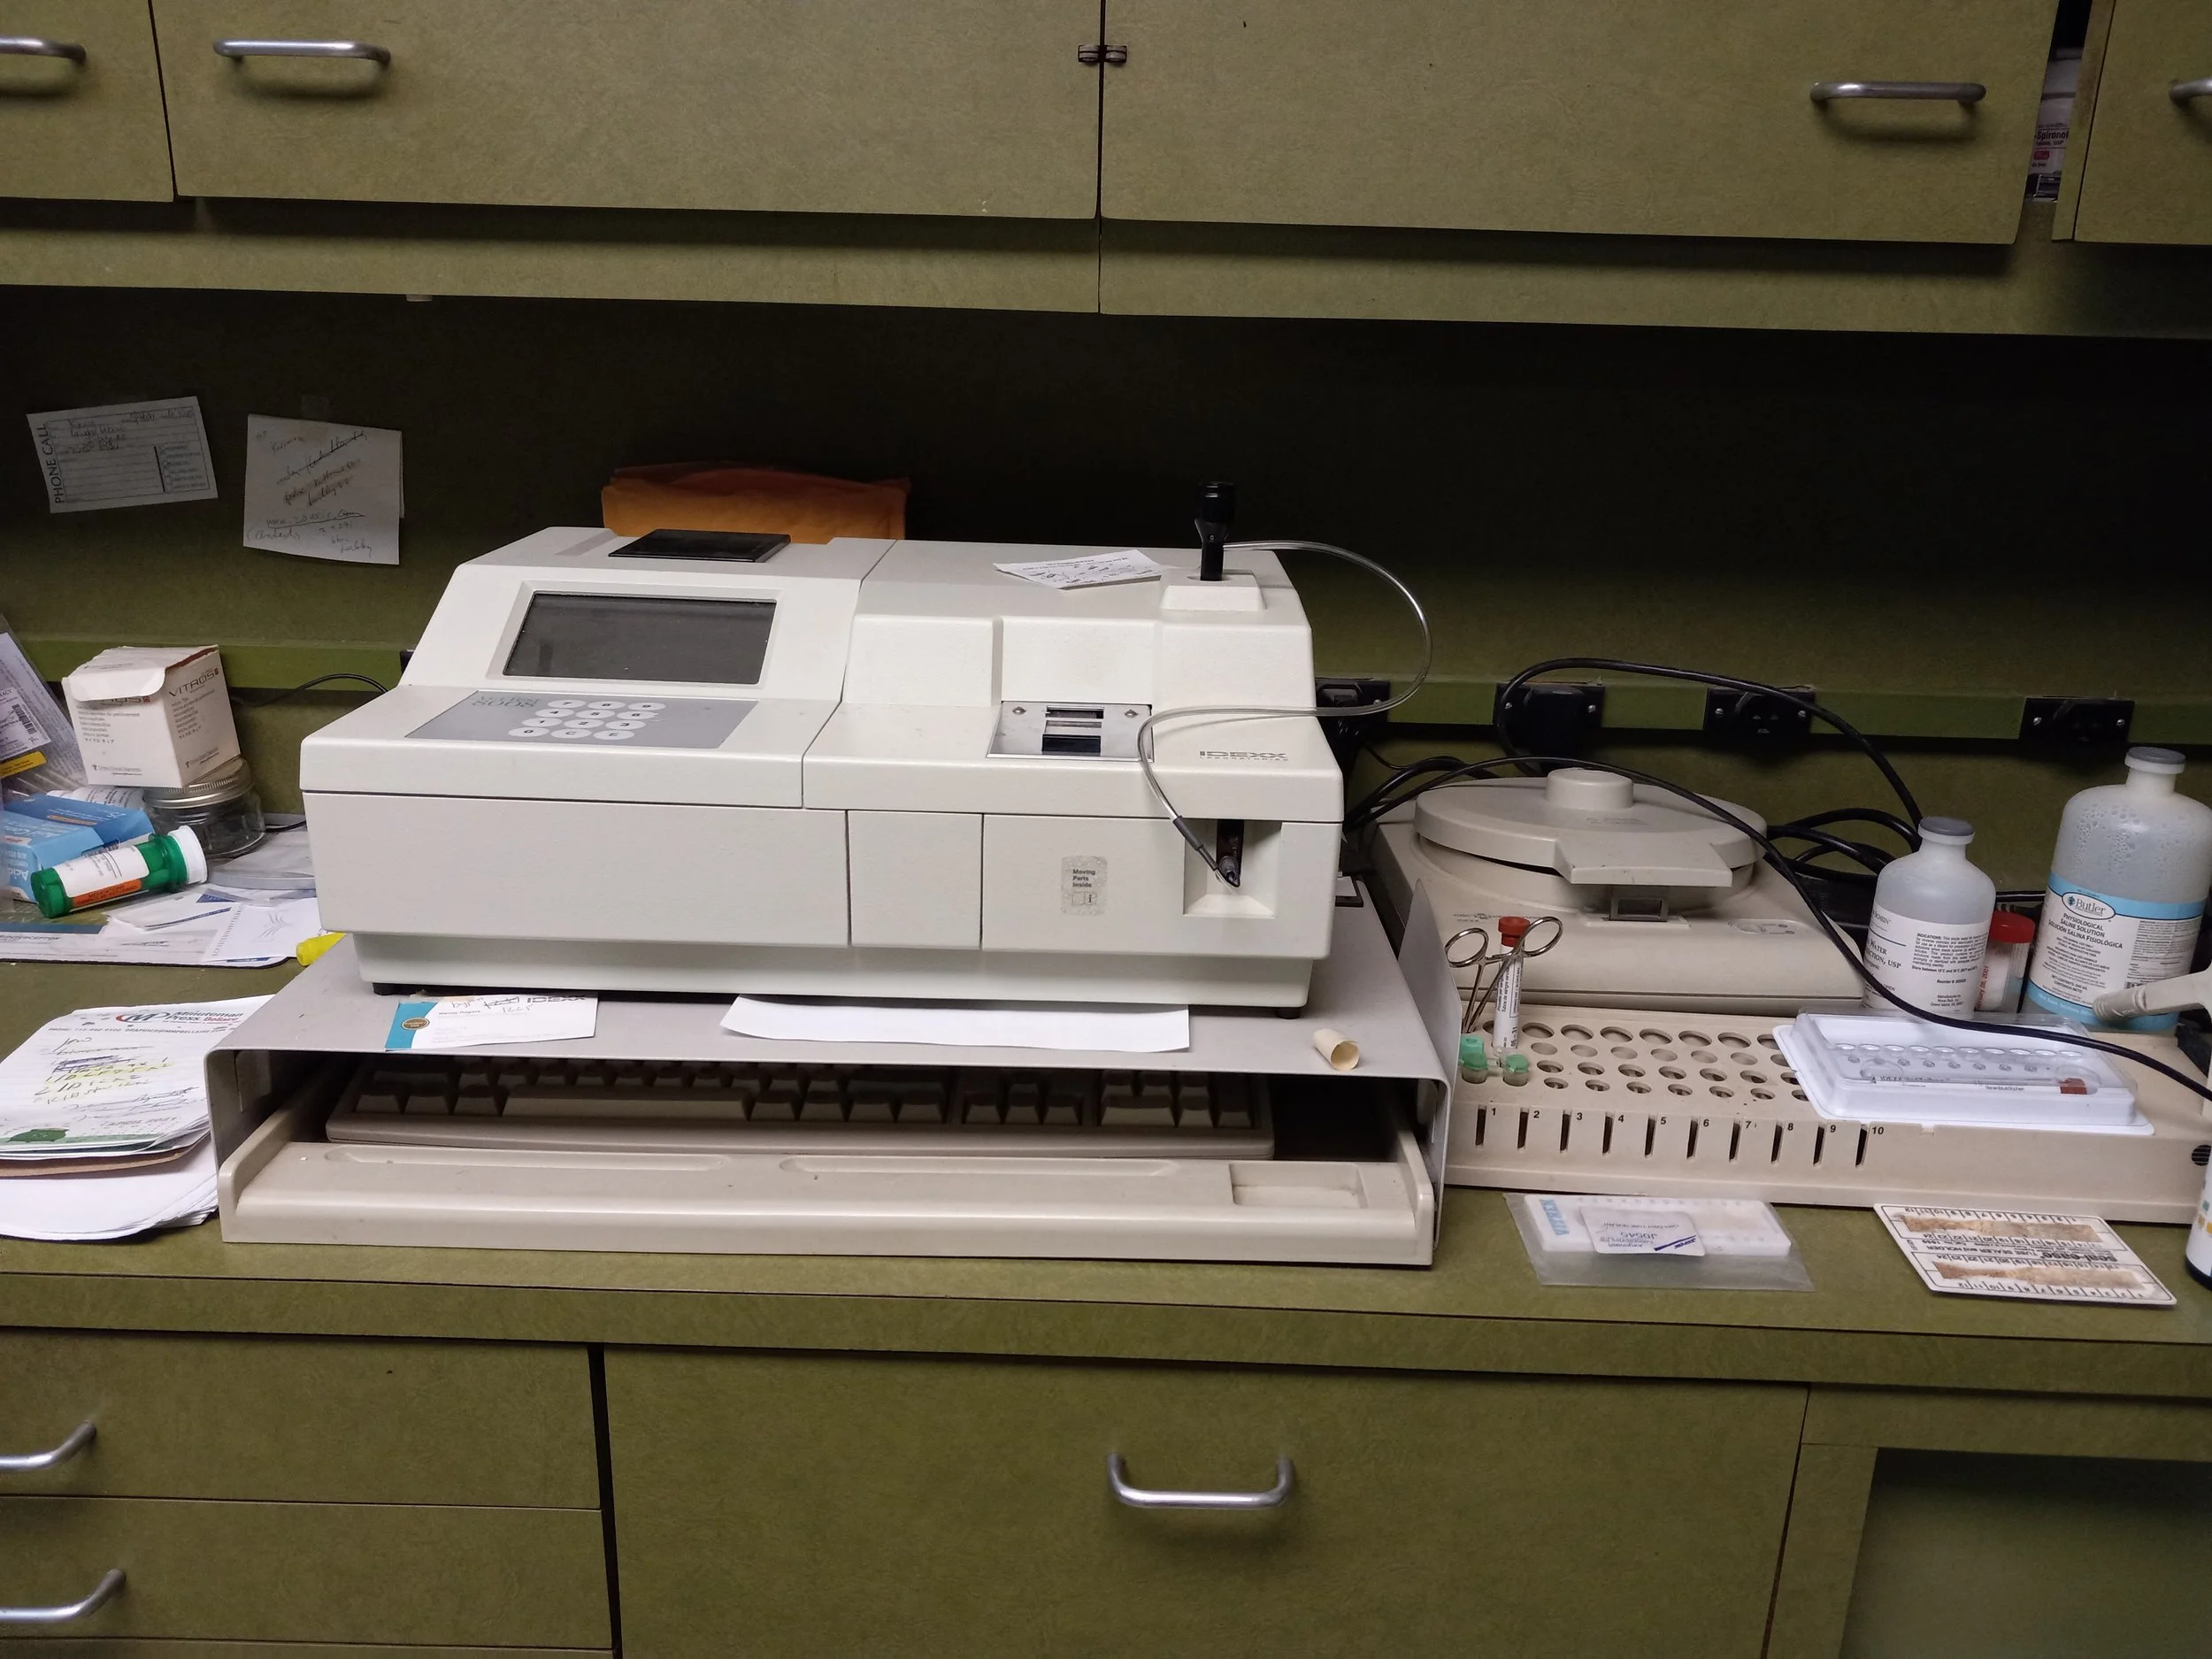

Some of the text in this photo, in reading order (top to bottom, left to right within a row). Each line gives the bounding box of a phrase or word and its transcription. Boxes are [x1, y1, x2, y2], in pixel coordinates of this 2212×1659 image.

[37, 423, 65, 504] PHONE CALL
[168, 671, 215, 697] VITROS
[2076, 898, 2104, 914] Butler
[2063, 912, 2104, 931] PHYSIOLOGICAL
[2060, 918, 2105, 938] SALINE SOLUTION
[2067, 929, 2085, 941] SALINA
[1870, 940, 1887, 956] WATER
[1887, 959, 1901, 969] USP
[1491, 1107, 1496, 1116] 1
[1532, 1110, 1540, 1118] 2
[1576, 1112, 1583, 1121] 3
[1617, 1114, 1624, 1123] 4
[1660, 1117, 1666, 1125] 5
[1702, 1118, 1709, 1127] 6
[1745, 1120, 1752, 1129] 7
[1830, 1125, 1836, 1133] 9
[1871, 1126, 1884, 1135] 10
